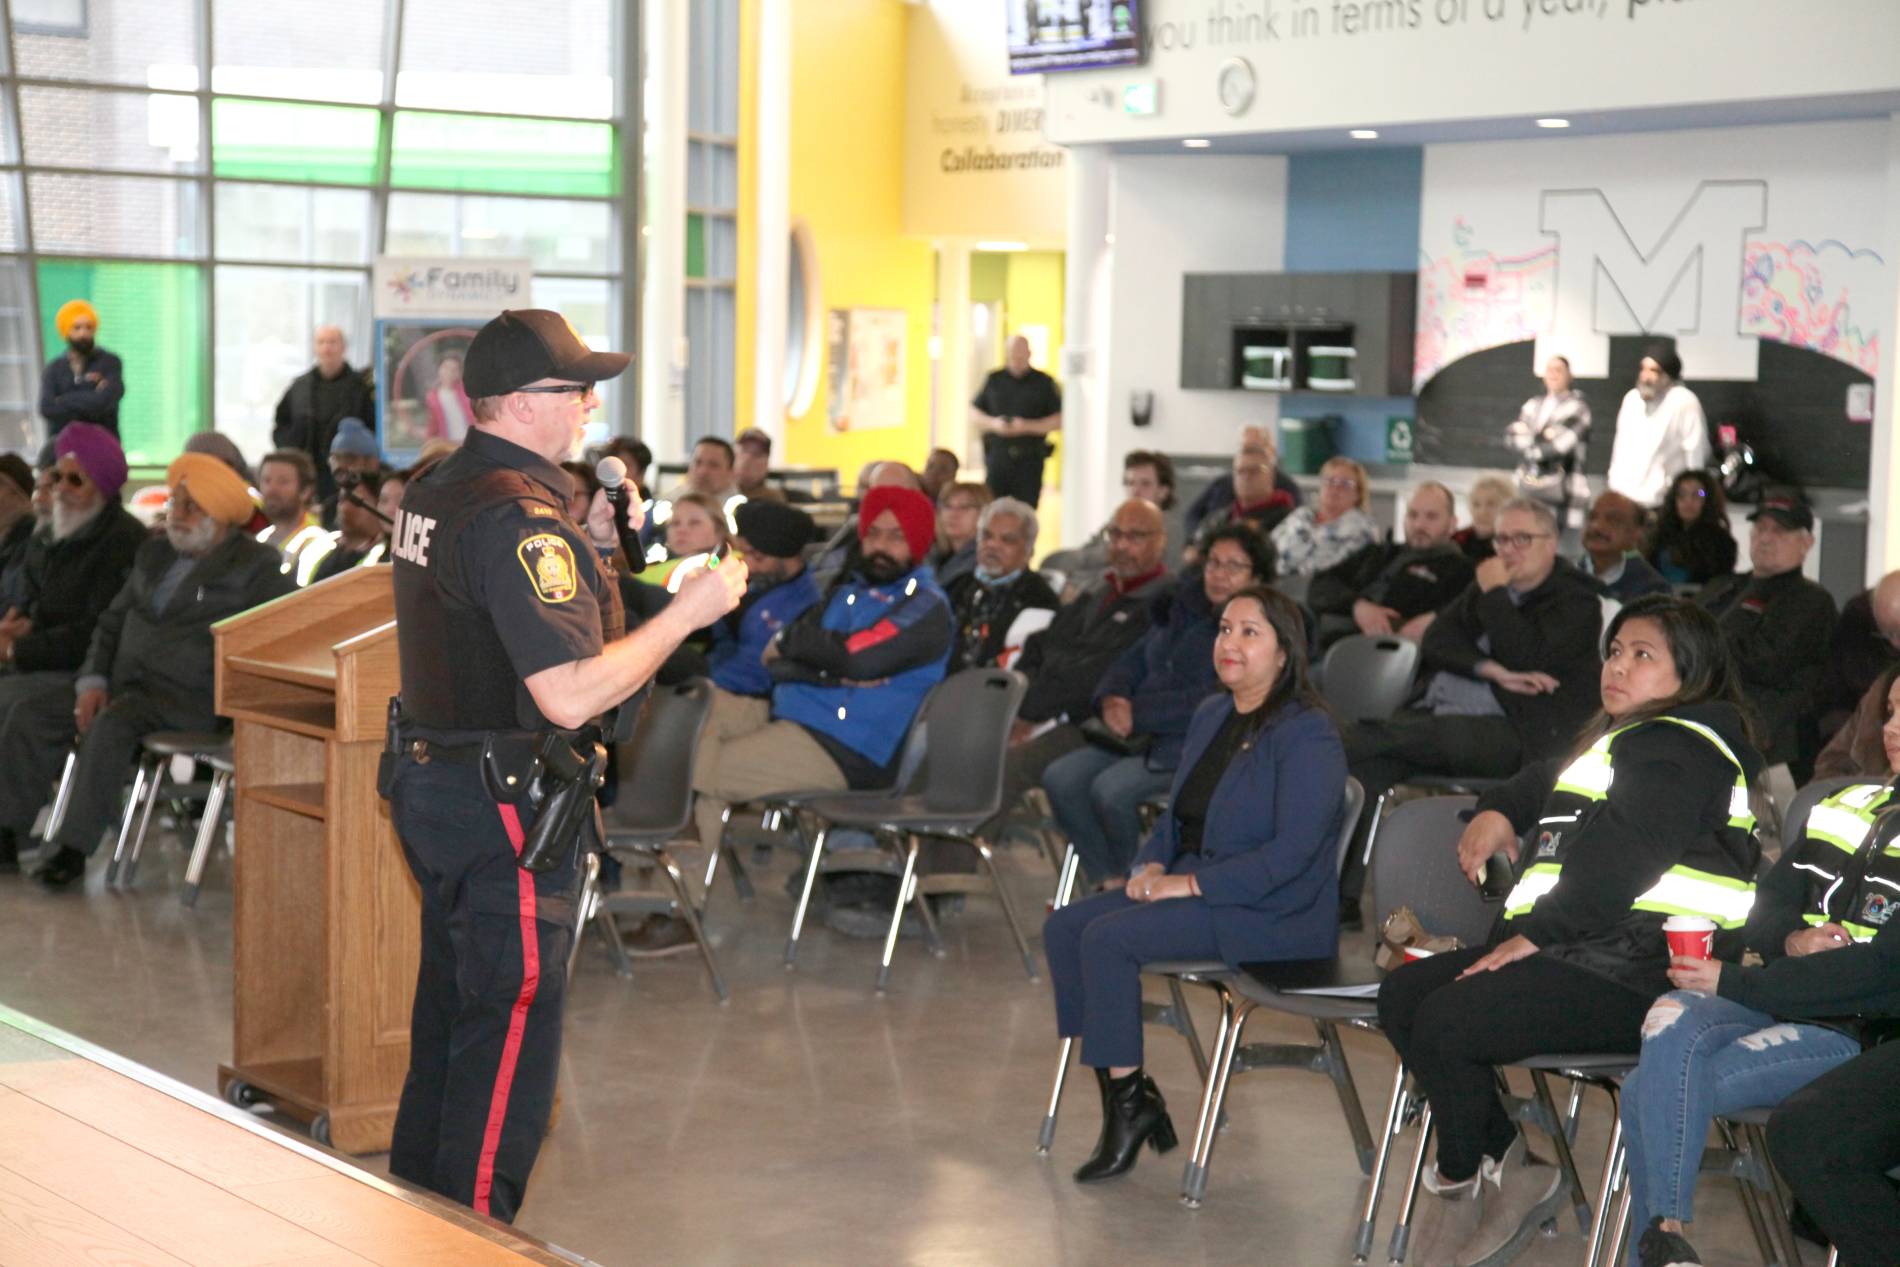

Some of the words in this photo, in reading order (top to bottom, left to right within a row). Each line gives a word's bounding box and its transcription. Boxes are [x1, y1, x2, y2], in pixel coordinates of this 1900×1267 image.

[1206, 0, 1280, 45] think
[1290, 0, 1320, 37] in
[427, 267, 520, 294] Family
[391, 509, 437, 567] LICE
[526, 537, 564, 552] POLICE
